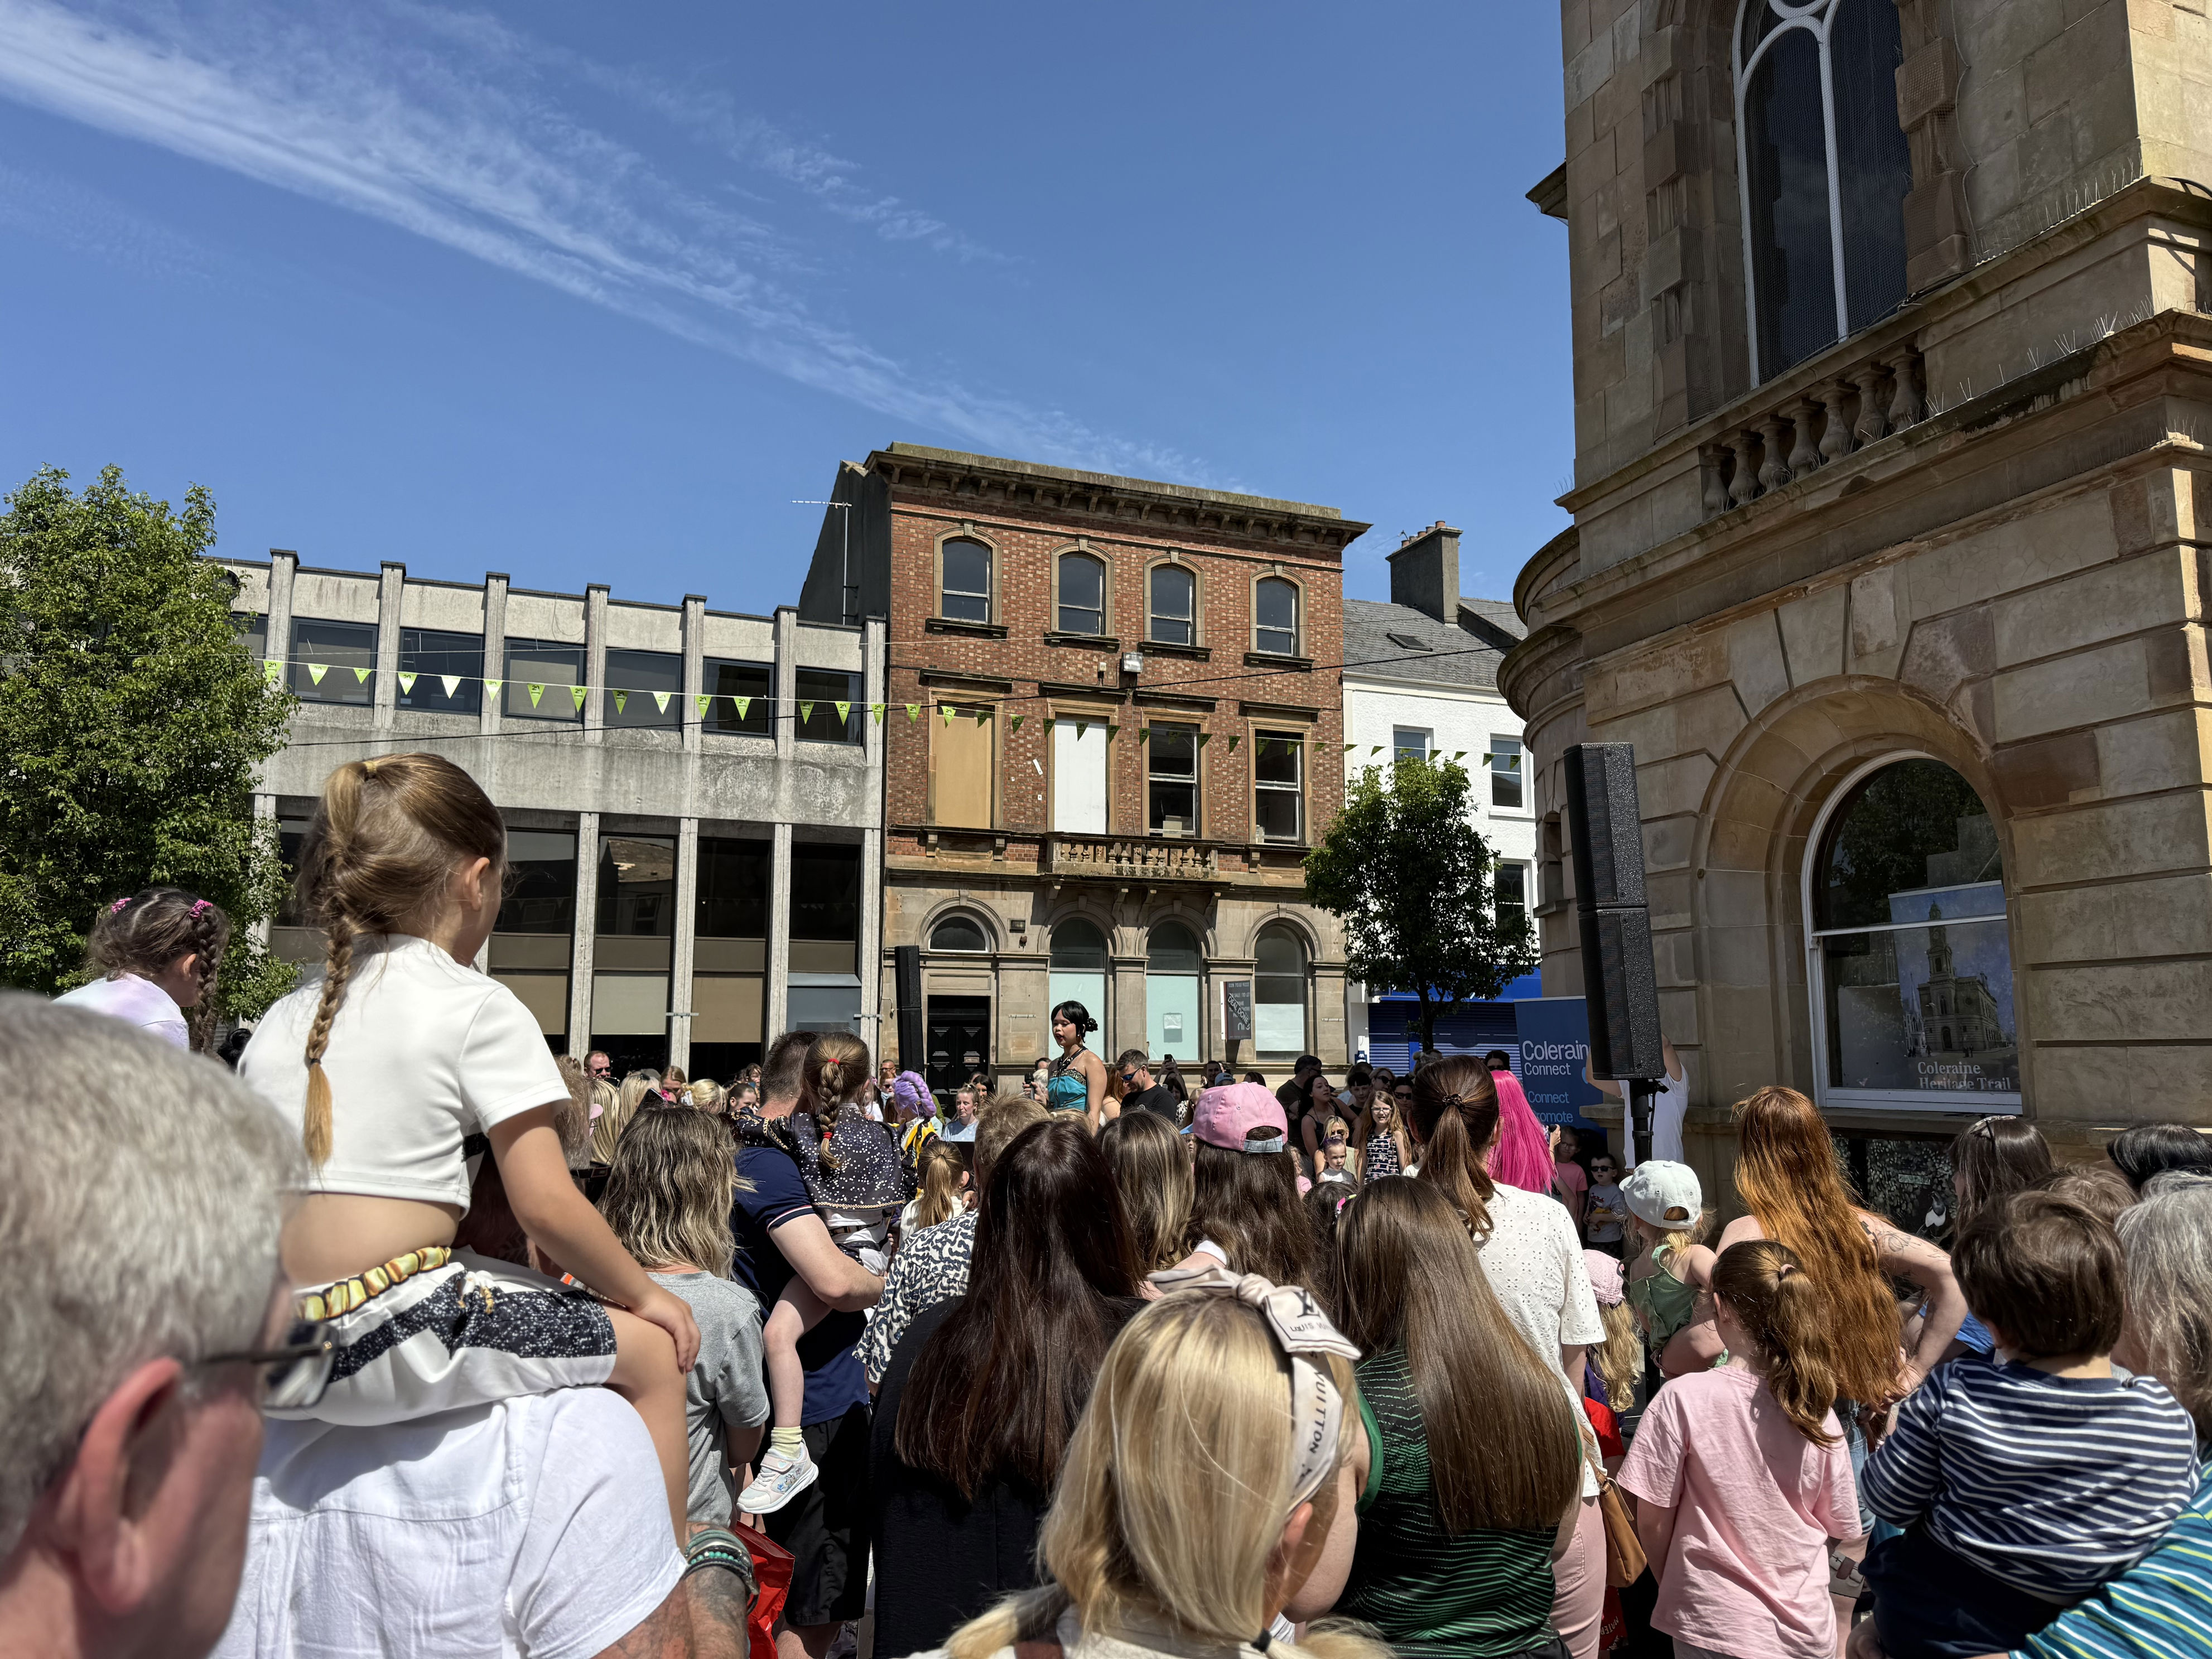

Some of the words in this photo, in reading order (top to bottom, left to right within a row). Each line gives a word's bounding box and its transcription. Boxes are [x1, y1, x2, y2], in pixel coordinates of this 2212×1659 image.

[1227, 996, 1238, 1011] DEAL
[1237, 1008, 1249, 1024] DONE
[1522, 1040, 1590, 1060] Colerain
[1524, 1062, 1572, 1076] Connect
[1917, 1061, 1981, 1074] Coleraine
[1919, 1077, 1974, 1089] Heritage
[1977, 1077, 2011, 1089] Trail
[1528, 1091, 1570, 1103] Connect
[1534, 1110, 1574, 1123] romote
[1309, 1371, 1327, 1454] VUITTON
